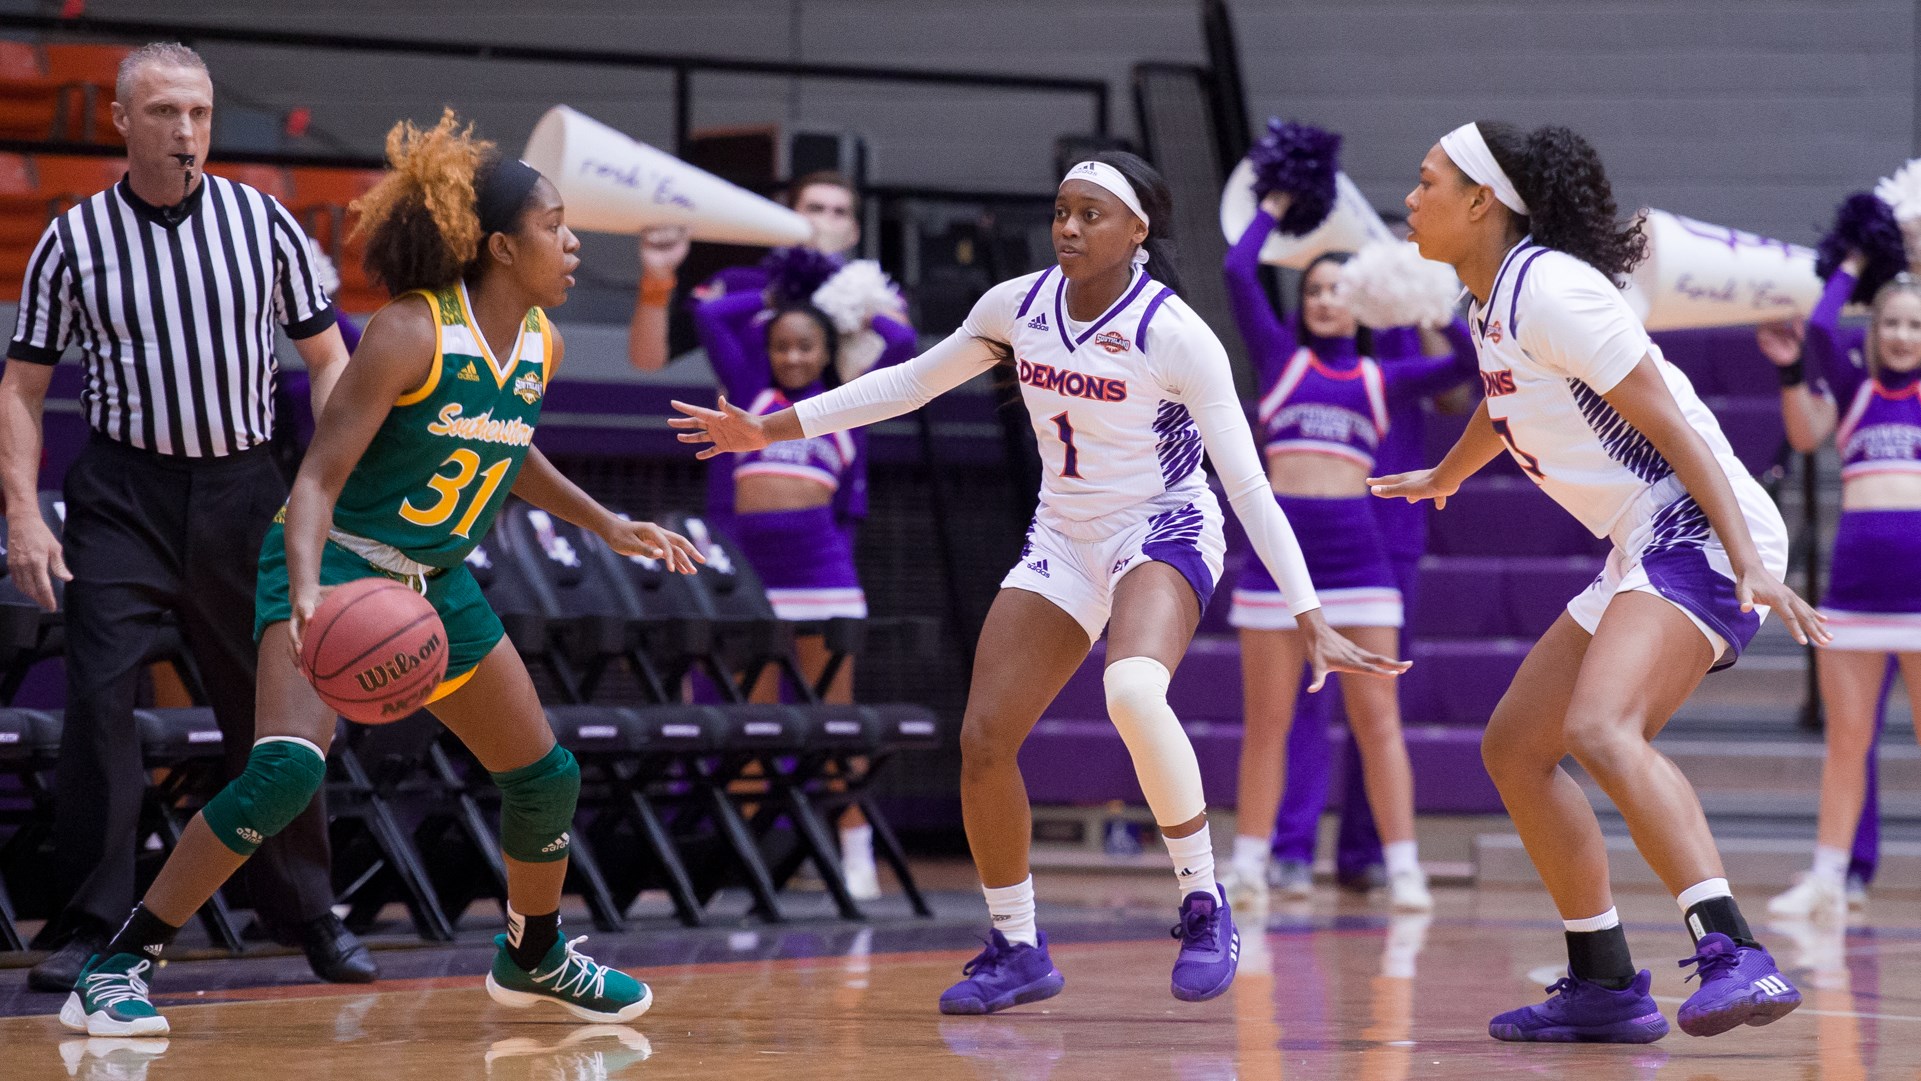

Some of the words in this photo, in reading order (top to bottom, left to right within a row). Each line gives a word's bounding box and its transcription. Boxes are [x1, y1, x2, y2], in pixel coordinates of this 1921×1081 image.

[1027, 321, 1050, 332] adidas
[1096, 333, 1130, 351] SOUTHLAND
[1019, 358, 1128, 402] DEMONS
[1049, 410, 1086, 480] 1
[398, 447, 512, 540] 31
[1027, 562, 1050, 579] adidas
[355, 632, 440, 693] Wilson
